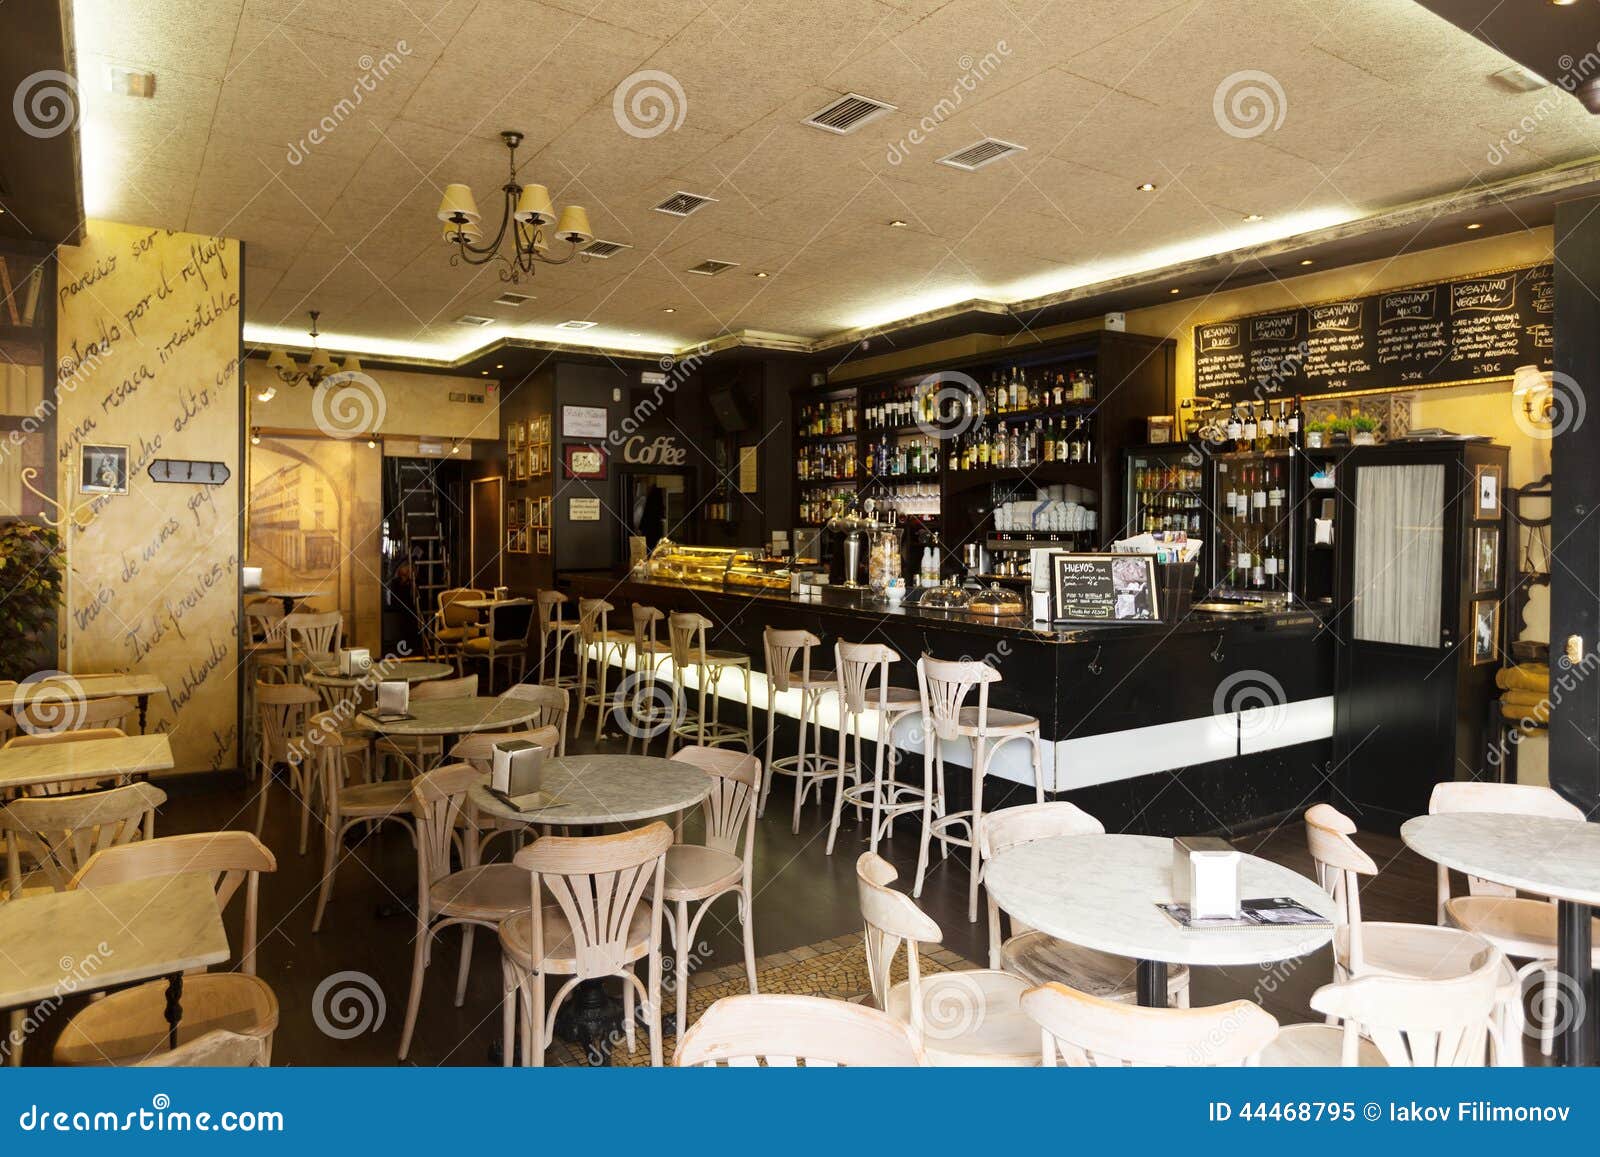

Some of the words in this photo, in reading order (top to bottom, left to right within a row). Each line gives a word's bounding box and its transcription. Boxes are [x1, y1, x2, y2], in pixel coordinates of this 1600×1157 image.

[1453, 280, 1506, 296] DESAYUNO
[1456, 294, 1500, 307] VEGETAL
[129, 433, 162, 479] ucho
[623, 435, 687, 465] Coffee
[1063, 563, 1095, 573] HUEVOS
